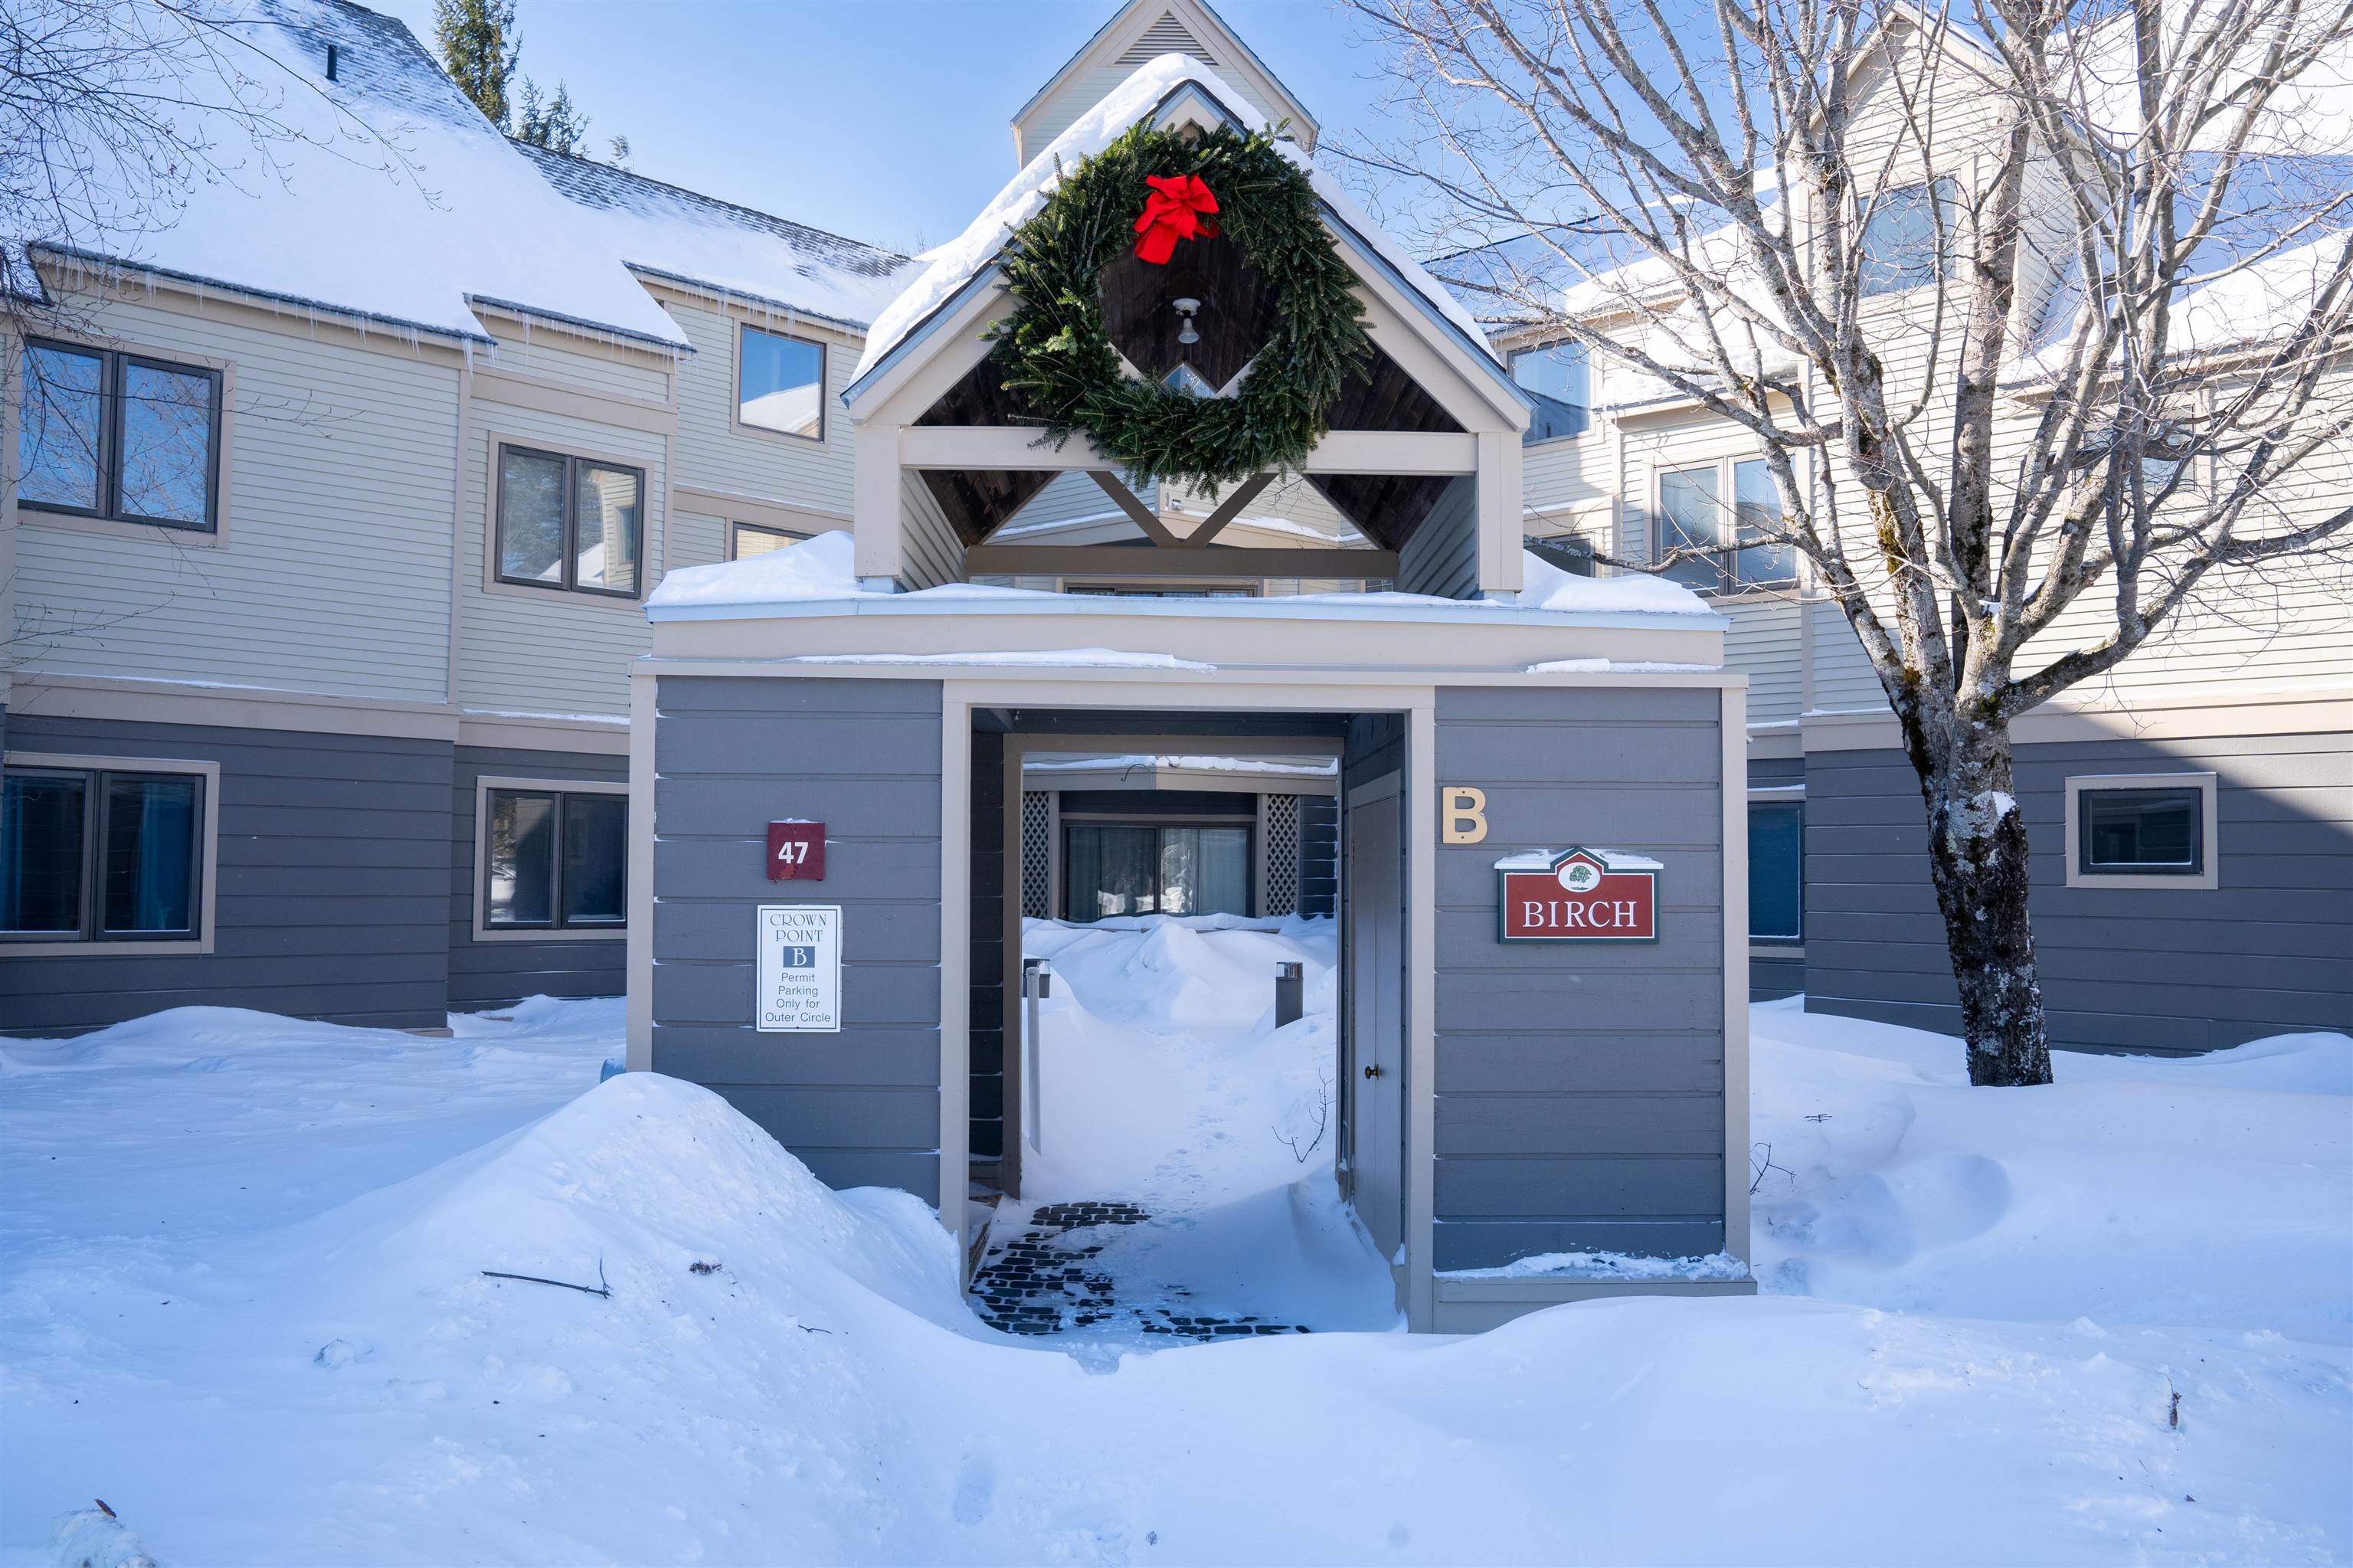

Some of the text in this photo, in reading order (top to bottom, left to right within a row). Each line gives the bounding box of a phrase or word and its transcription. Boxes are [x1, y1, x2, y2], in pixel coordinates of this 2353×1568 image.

[1442, 787, 1487, 844] B
[778, 842, 808, 864] 47
[770, 914, 826, 926] CROWN
[1522, 901, 1638, 928] BIRCH
[775, 930, 823, 942] POINT
[792, 948, 807, 967] B
[781, 973, 815, 982] Permit
[778, 986, 818, 997] Parking
[776, 999, 820, 1010] Only for
[765, 1012, 831, 1022] Outer Circle
